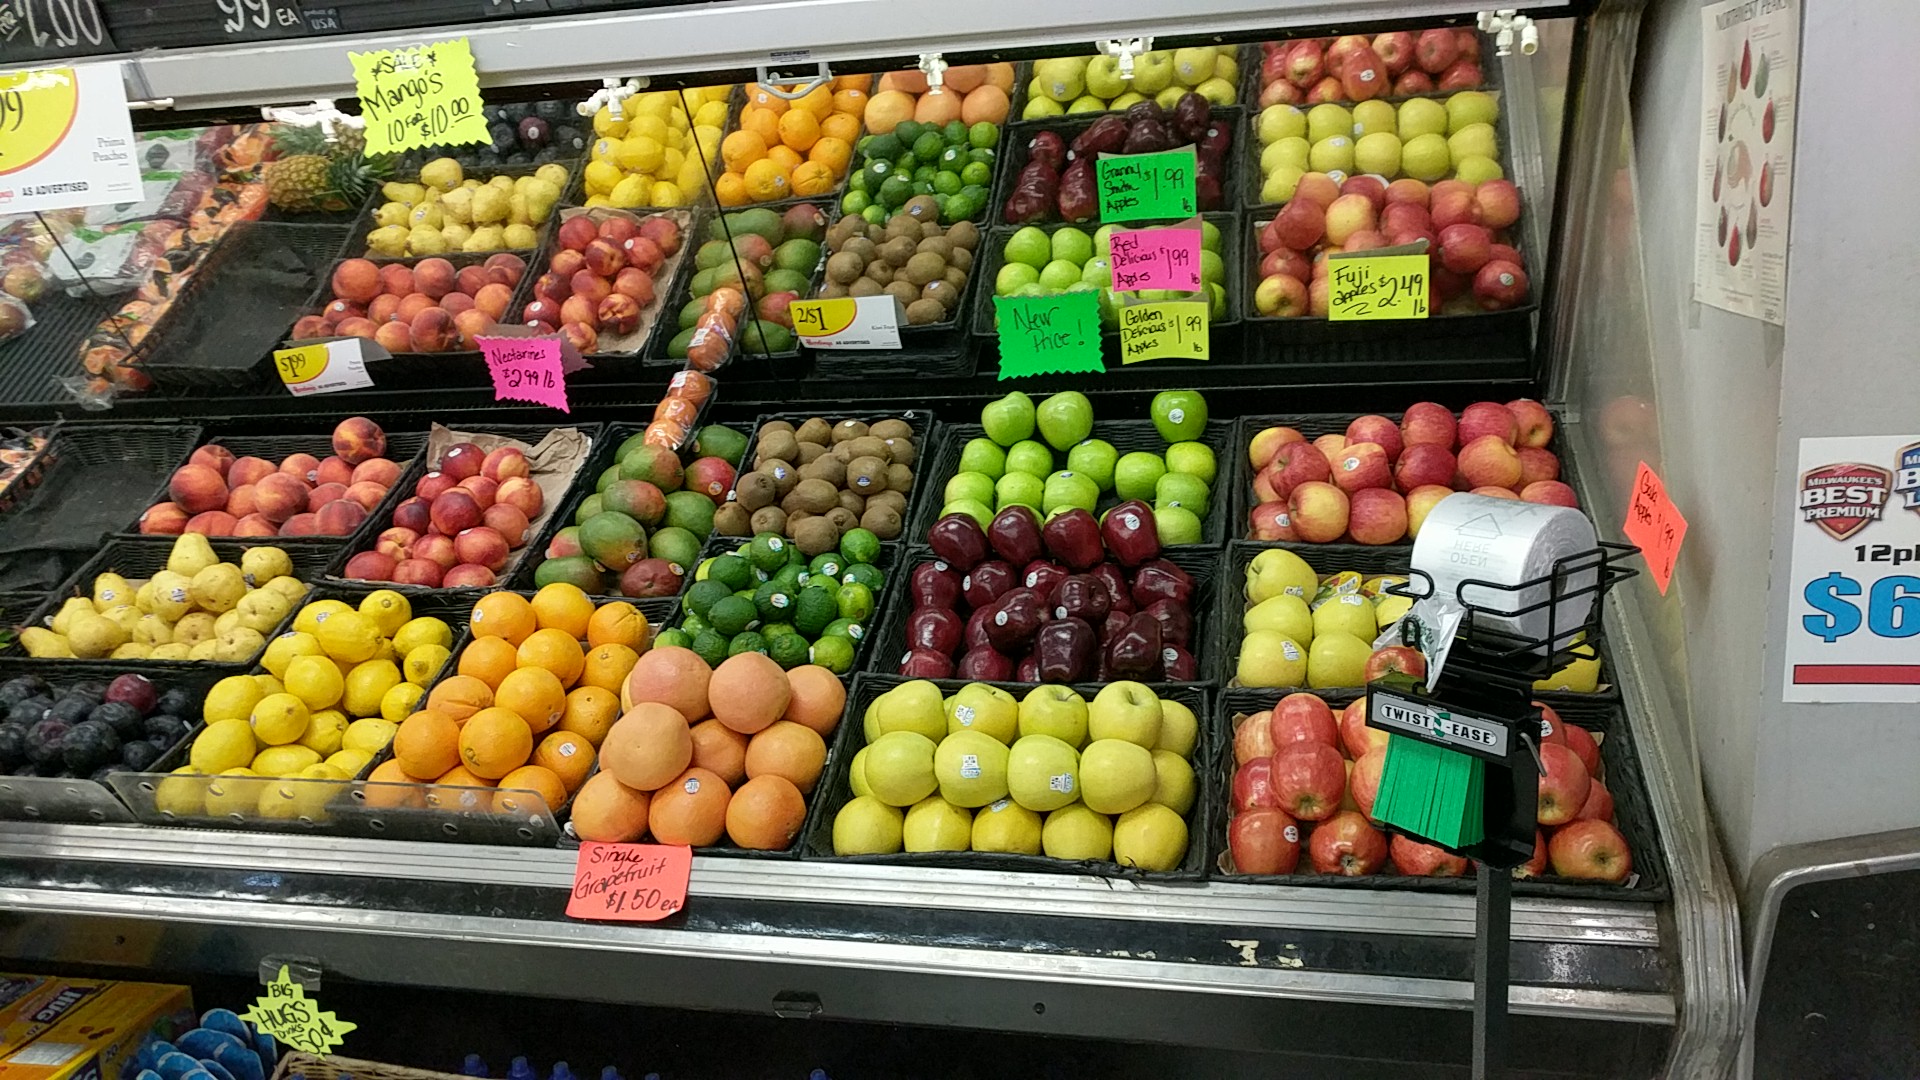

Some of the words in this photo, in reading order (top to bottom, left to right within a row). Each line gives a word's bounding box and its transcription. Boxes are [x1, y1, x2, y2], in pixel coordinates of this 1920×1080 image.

[311, 17, 337, 30] USA
[363, 70, 444, 121] Mango's
[388, 119, 405, 145] 10
[93, 149, 128, 162] Peaches
[22, 186, 33, 196] AS
[36, 181, 89, 195] ADVERTISED
[1110, 234, 1138, 254] Red
[1333, 265, 1370, 288] Fuji
[1013, 303, 1060, 330] New
[1125, 308, 1163, 326] Golden
[491, 346, 547, 367] Nectarines
[543, 369, 555, 389] lb
[1802, 485, 1887, 508] BEST
[1806, 506, 1881, 520] PREMIUM
[1385, 706, 1430, 728] TWIST
[590, 846, 644, 872] Single
[574, 857, 667, 900] Grapefruit
[661, 898, 681, 911] ea
[271, 983, 293, 999] BIG
[36, 990, 83, 1020] HUG
[257, 1001, 310, 1030] HUGS
